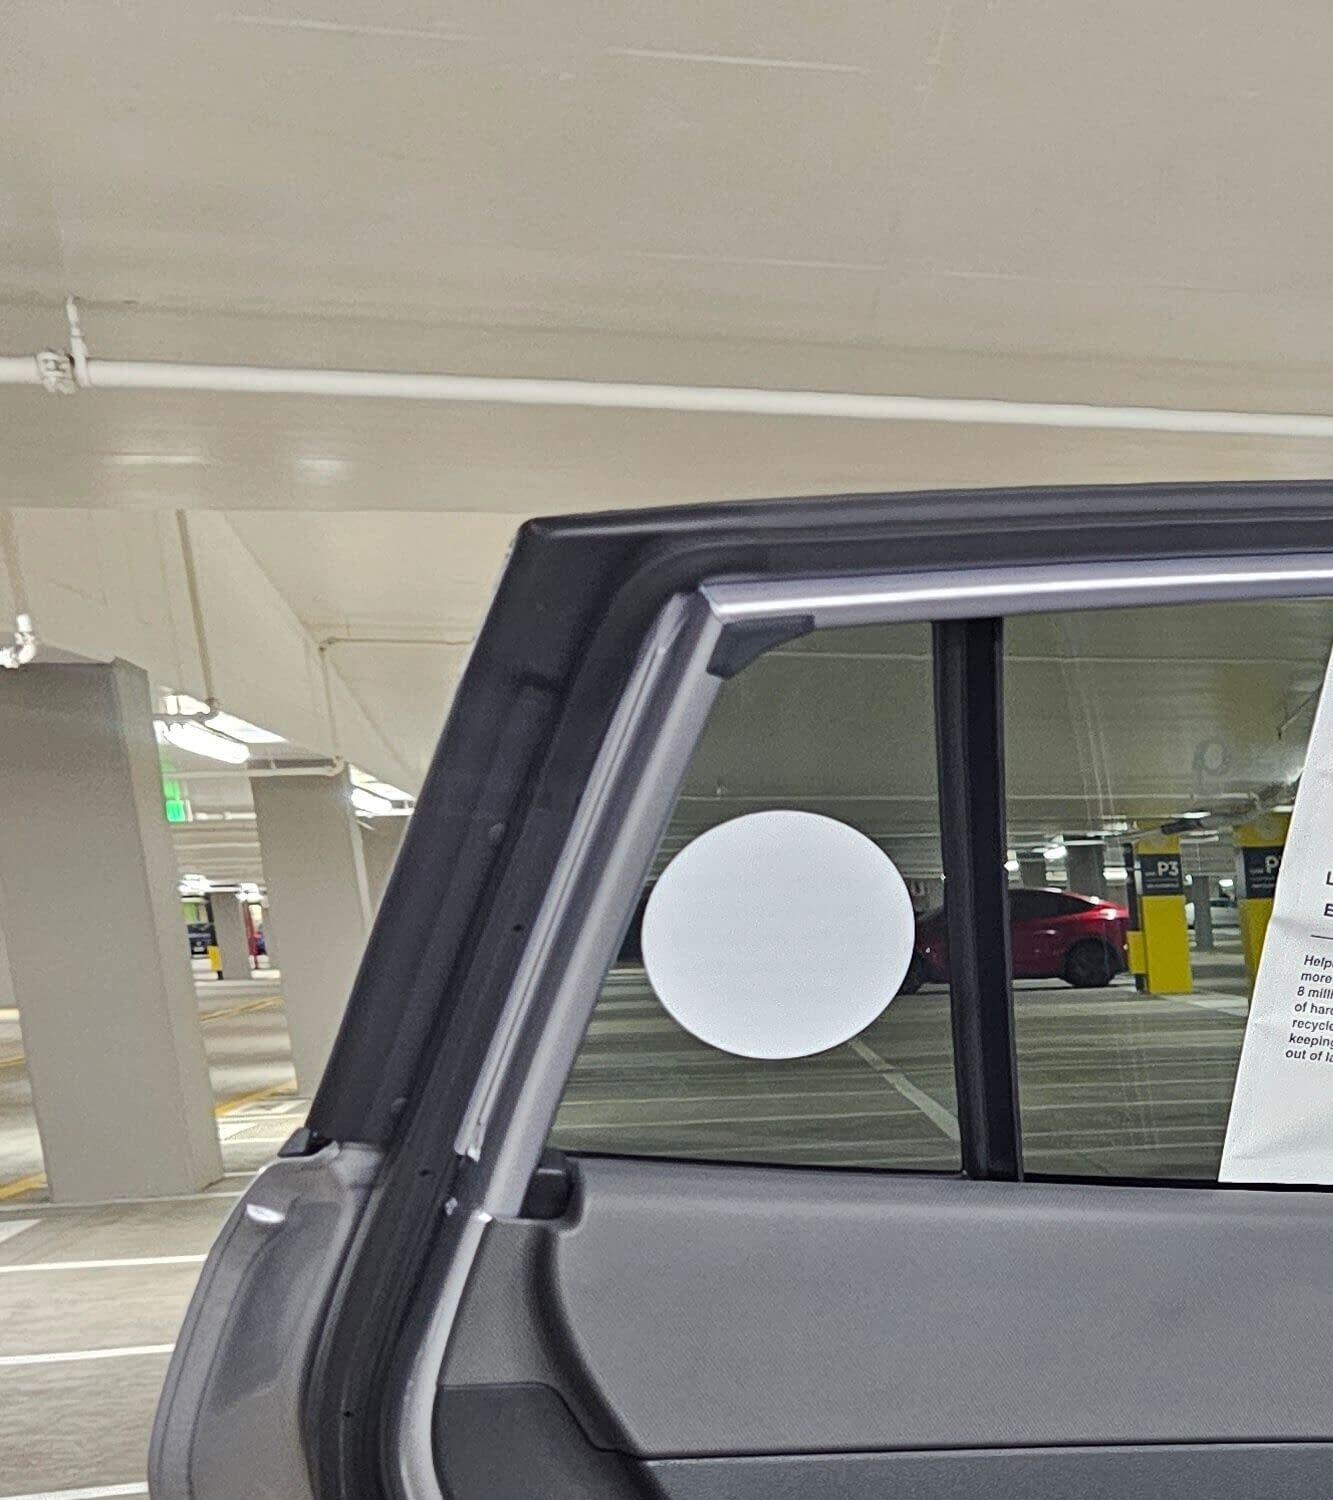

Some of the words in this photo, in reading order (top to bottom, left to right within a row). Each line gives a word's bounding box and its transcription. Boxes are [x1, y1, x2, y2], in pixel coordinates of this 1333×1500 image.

[1157, 861, 1179, 877] P3
[1301, 973, 1332, 983] more
[1297, 986, 1305, 996] 8
[1294, 1001, 1308, 1012] of
[1285, 1050, 1306, 1060] out
[1309, 1051, 1323, 1061] of
